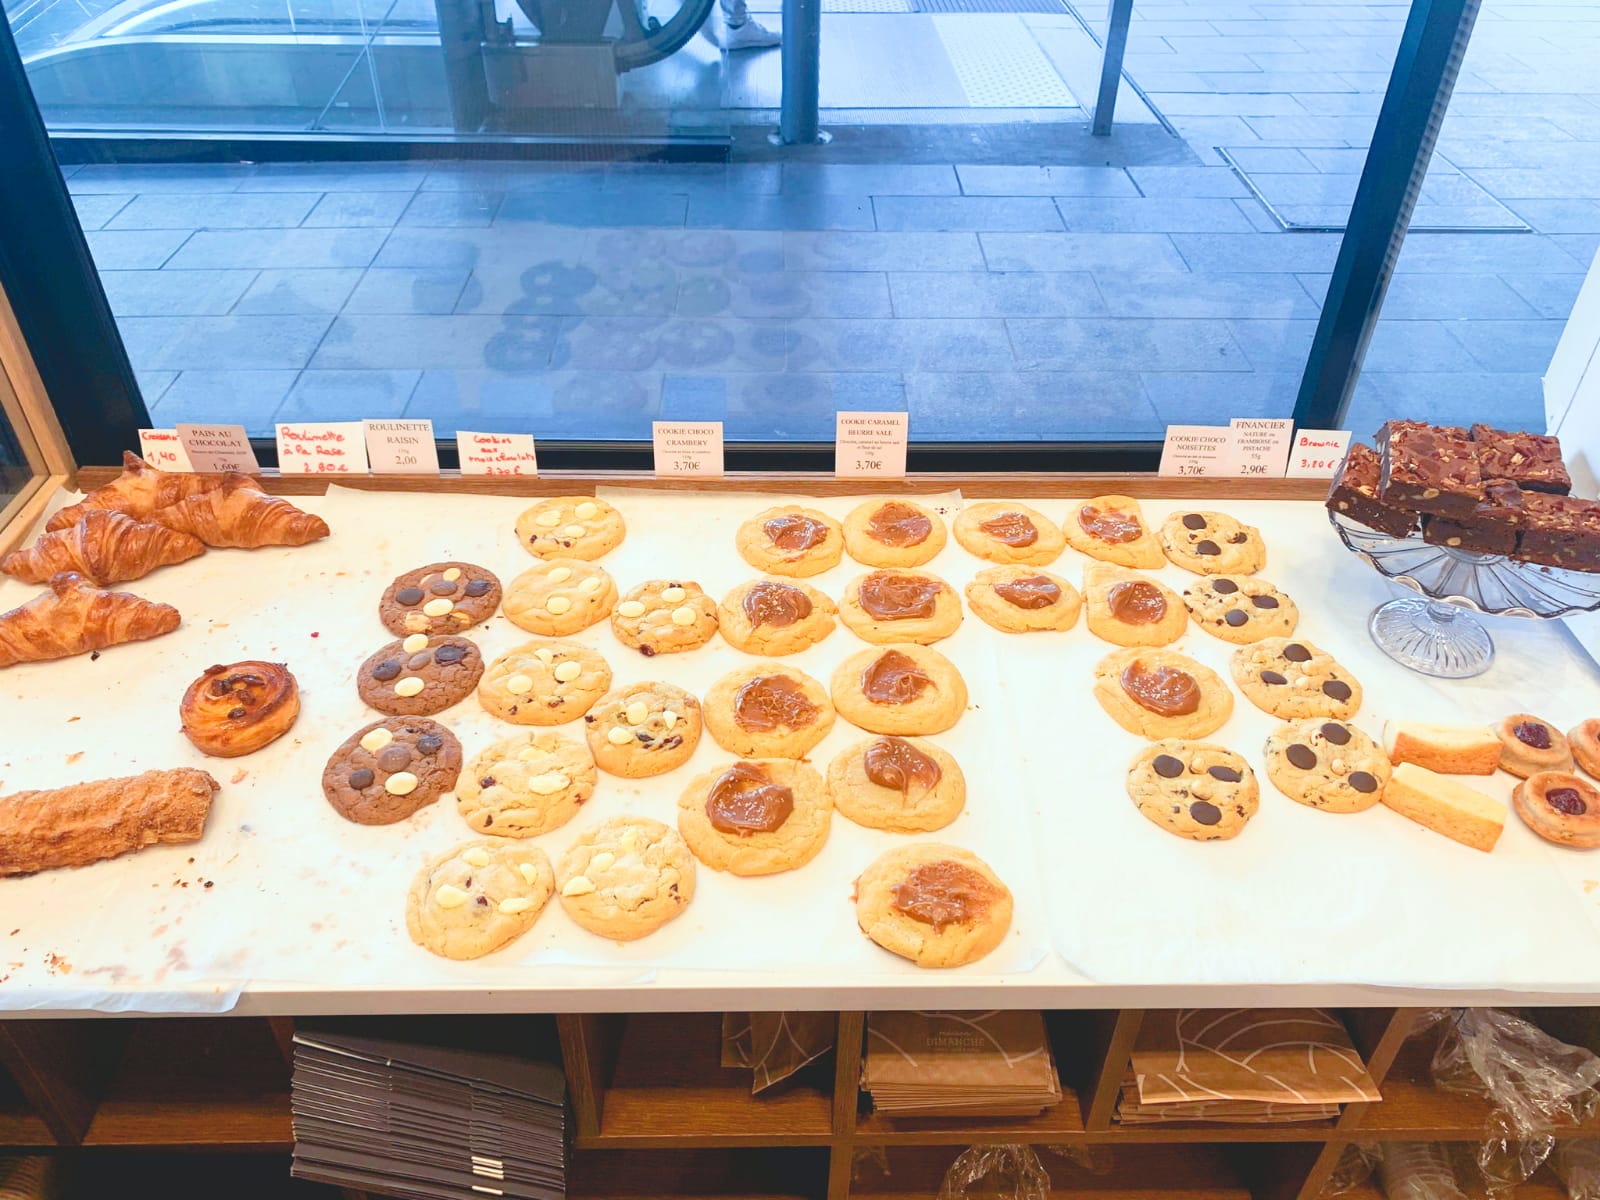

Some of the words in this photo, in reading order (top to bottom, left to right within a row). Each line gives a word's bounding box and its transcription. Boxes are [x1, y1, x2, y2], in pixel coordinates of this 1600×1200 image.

[369, 423, 430, 432] ROULINETTE
[1235, 421, 1286, 429] FINANCIER
[191, 429, 216, 438] PAIN
[217, 430, 232, 438] AU
[188, 439, 242, 448] CHOCOLAT
[386, 436, 419, 444] RAISIN
[1299, 437, 1340, 448] Brownie
[673, 461, 701, 471] 3,70€
[855, 460, 883, 470] 3,70€
[1240, 465, 1269, 474] 2,90€
[1177, 466, 1206, 475] 3,70€
[926, 1037, 985, 1048] DIMANCHE
